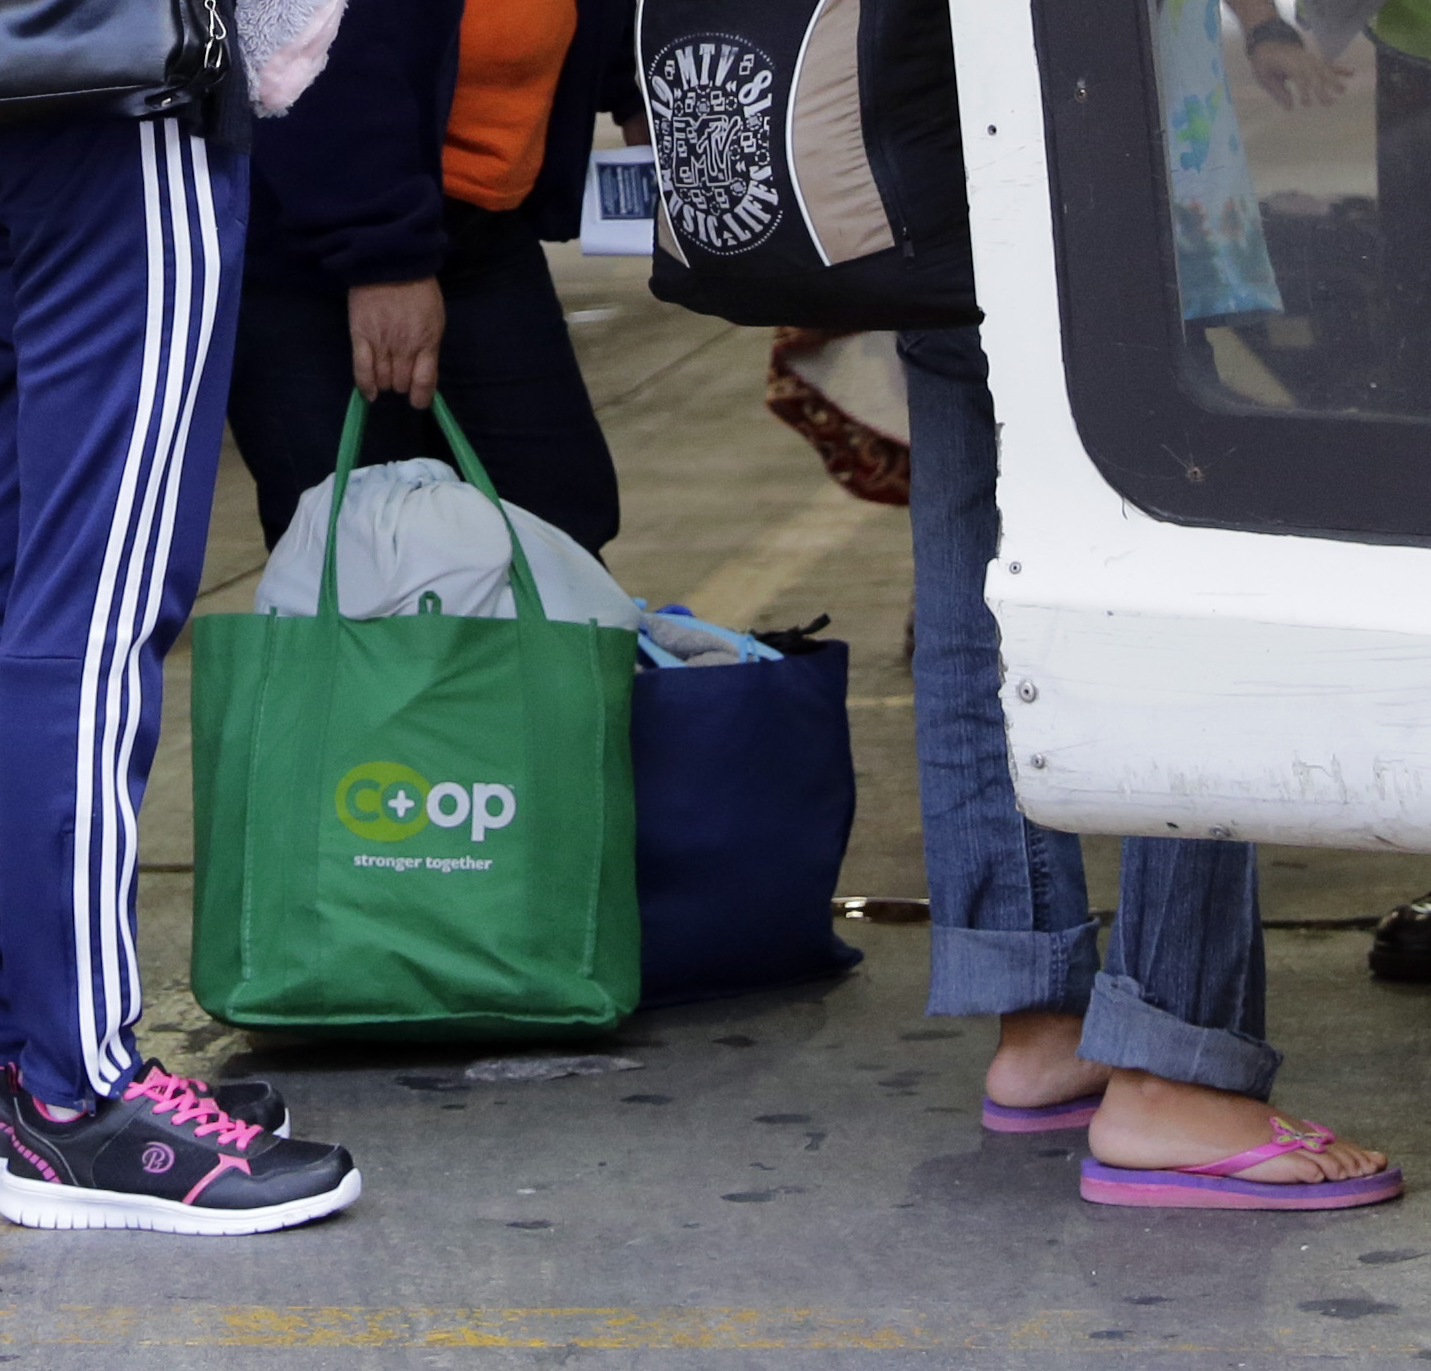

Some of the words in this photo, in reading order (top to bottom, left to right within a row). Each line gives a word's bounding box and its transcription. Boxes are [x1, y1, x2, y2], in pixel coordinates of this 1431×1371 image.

[675, 43, 739, 91] MTV
[353, 854, 422, 872] stronger
[425, 855, 493, 873] together
